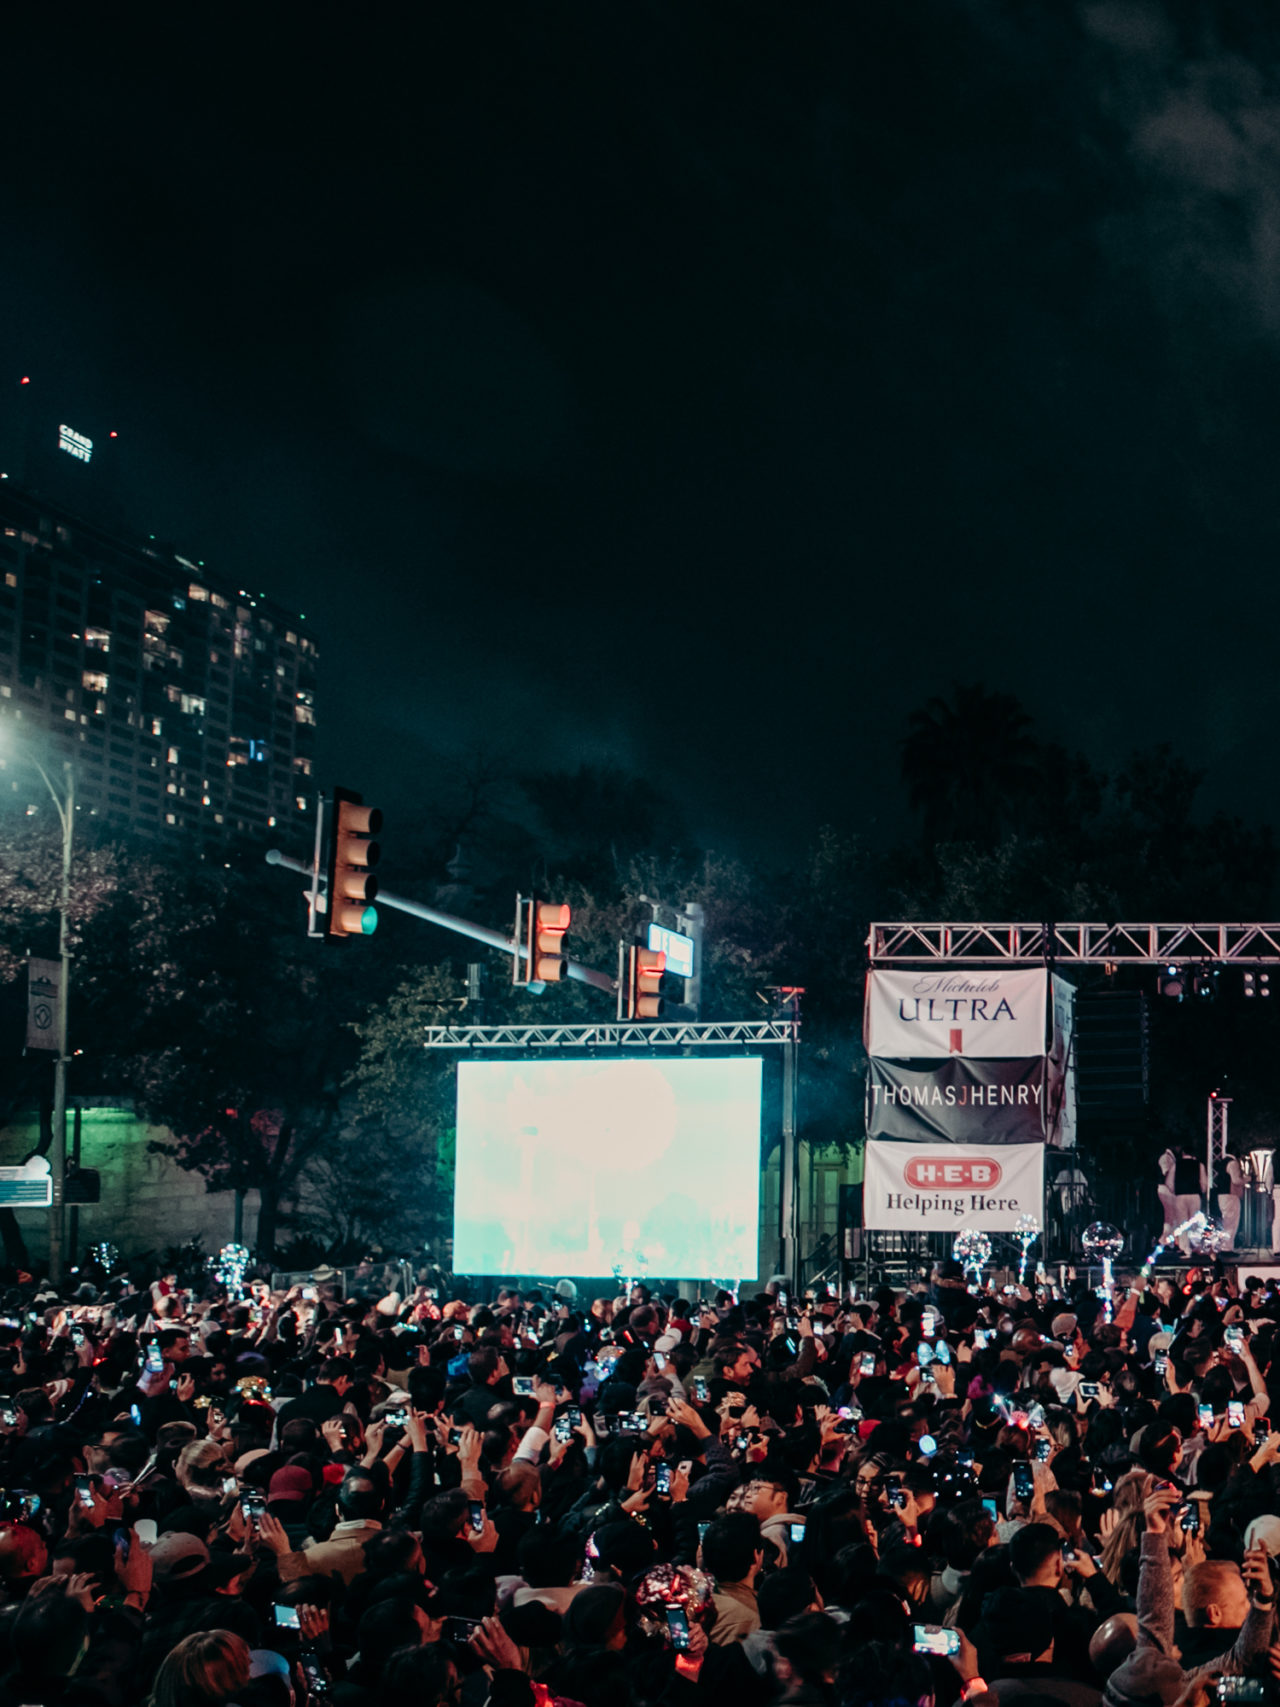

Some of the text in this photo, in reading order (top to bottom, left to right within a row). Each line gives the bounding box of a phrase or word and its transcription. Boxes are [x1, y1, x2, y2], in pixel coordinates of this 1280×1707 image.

[912, 975, 999, 994] Michelob
[899, 998, 1016, 1021] ULTRA
[887, 1194, 963, 1215] Helping
